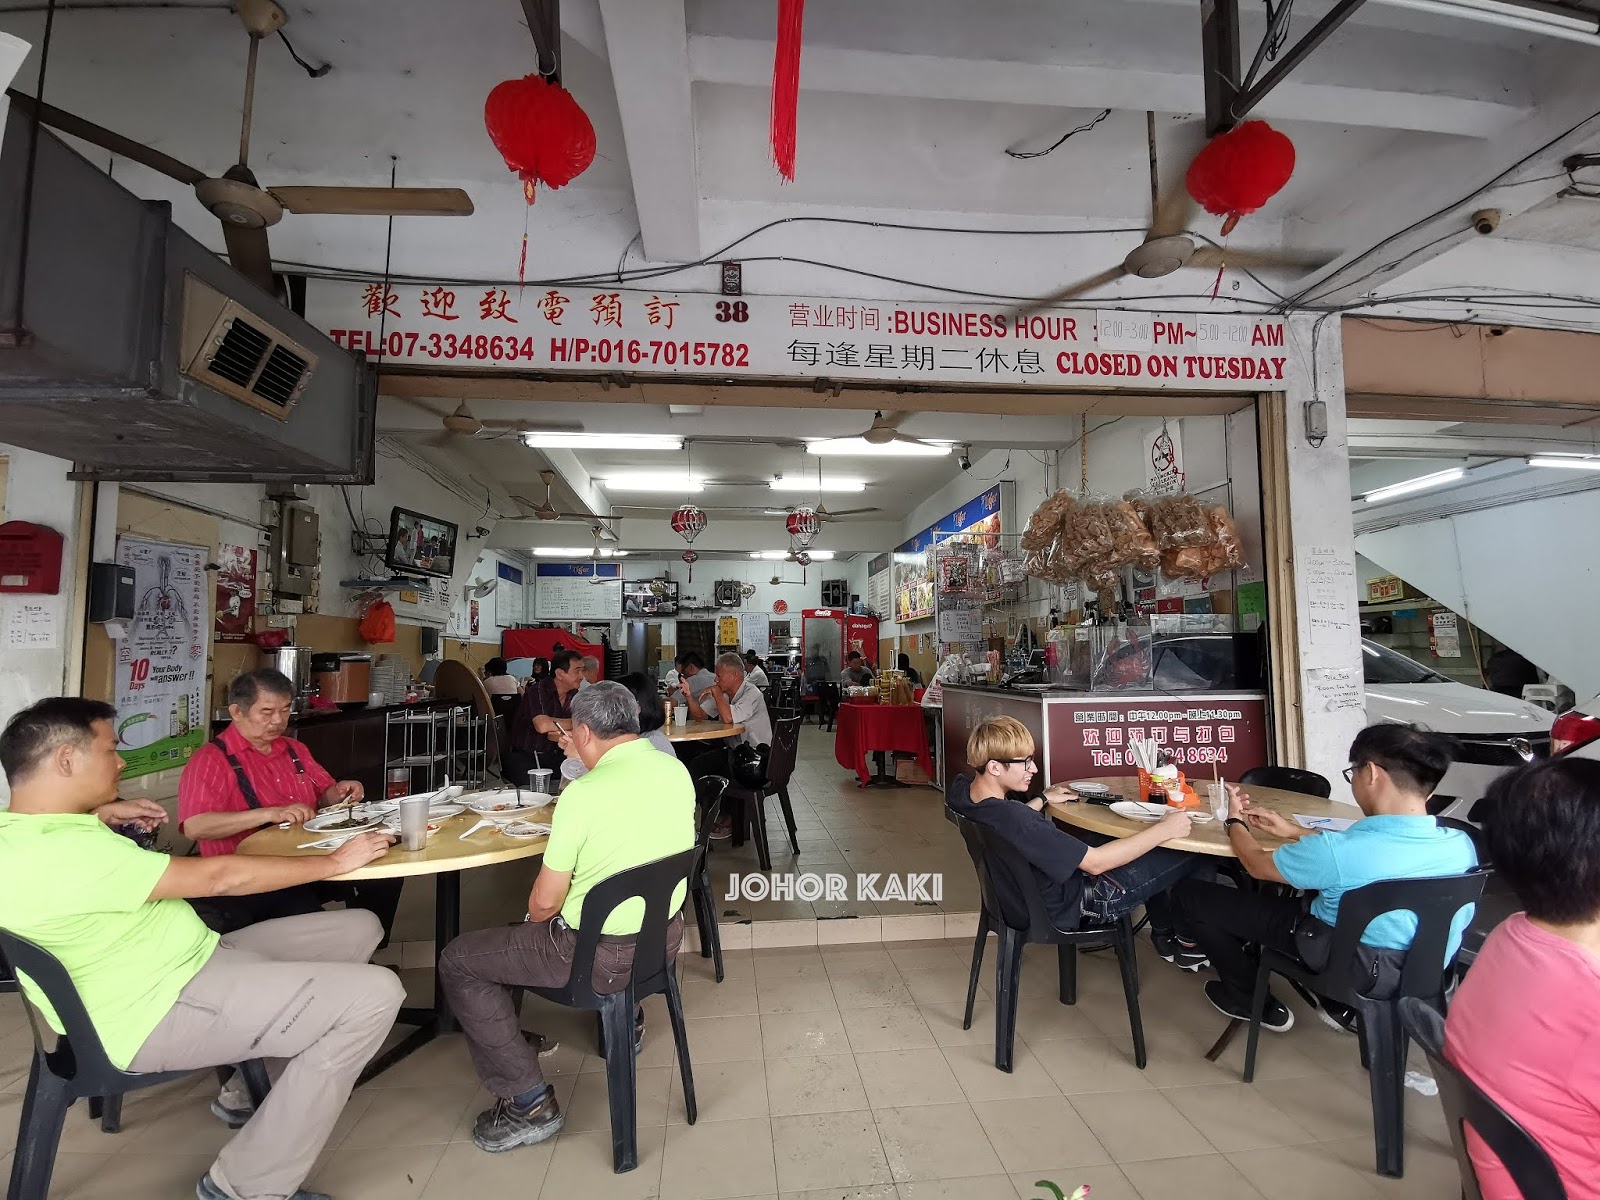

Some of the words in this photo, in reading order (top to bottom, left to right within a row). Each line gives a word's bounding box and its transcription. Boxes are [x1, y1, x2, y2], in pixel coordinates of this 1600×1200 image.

[361, 282, 680, 329] 歡迎致電預訂
[715, 301, 749, 322] 38
[788, 303, 880, 331] 营业时间
[1015, 315, 1077, 341] HOUR
[1251, 324, 1284, 347] AM
[550, 337, 749, 367] H/P:016-7015782
[786, 339, 1046, 374] 每逢星期二休息
[1056, 352, 1142, 376] CLOSED
[1147, 355, 1178, 377] ON
[1183, 355, 1287, 380] TUESDAY
[130, 658, 150, 681] 10
[152, 666, 165, 674] Your
[166, 664, 182, 673] Body
[129, 682, 145, 691] Days
[1083, 726, 1235, 746] 欢迎预订与打包
[1092, 750, 1122, 766] Tel:
[1187, 747, 1228, 764] 8634
